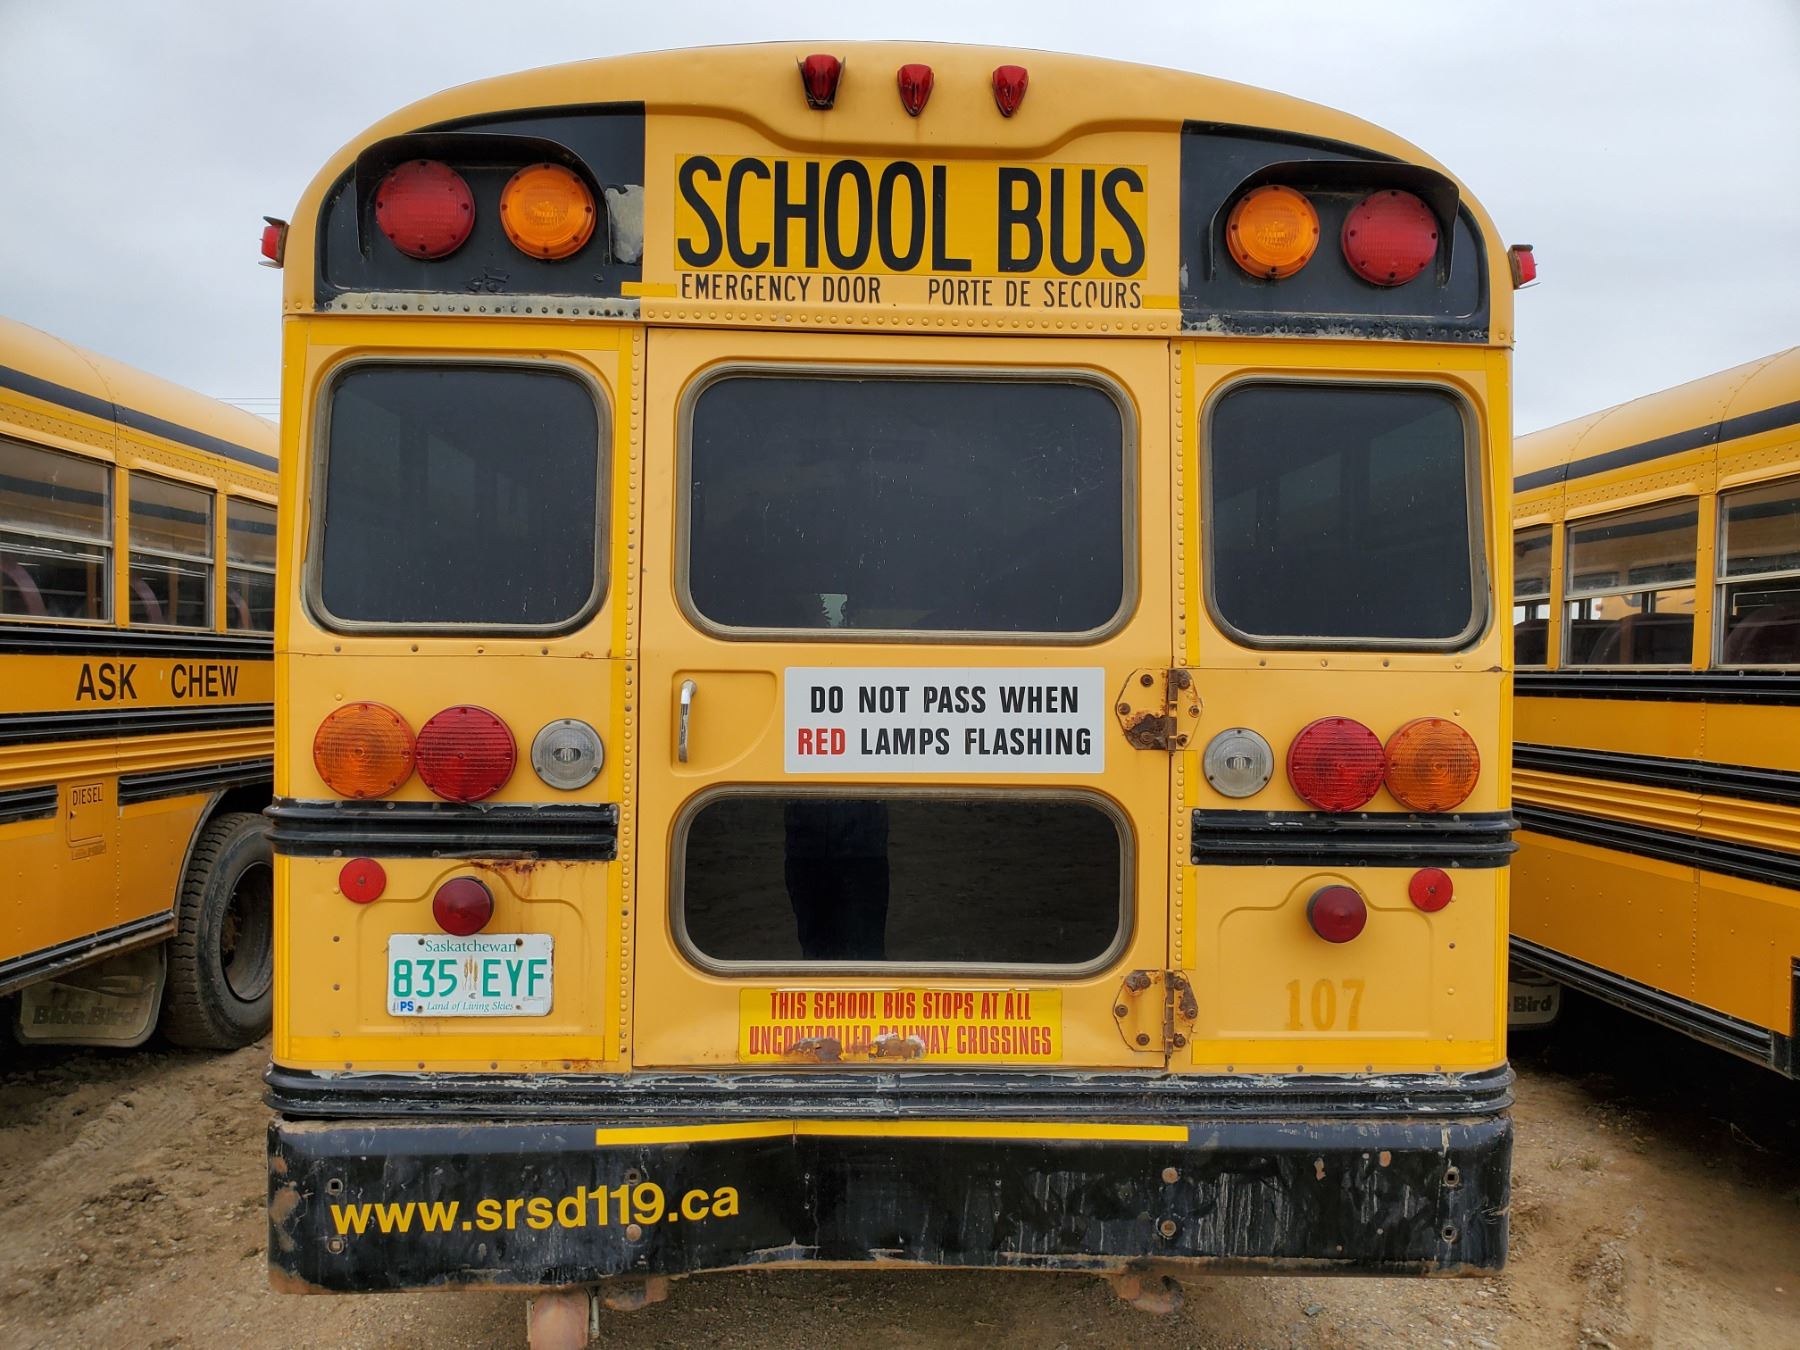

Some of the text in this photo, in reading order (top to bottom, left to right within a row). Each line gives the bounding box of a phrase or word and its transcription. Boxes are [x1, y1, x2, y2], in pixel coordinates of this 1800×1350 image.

[677, 155, 1146, 278] SCHOOL BUS
[681, 273, 881, 304] EMERGENCY DOOR
[928, 278, 1142, 309] PORTE DE SECOURS
[75, 662, 239, 701] ASK CHEW
[810, 686, 1079, 713] DO NOT PASS WHEN
[797, 728, 1091, 756] RED LAMPS FLASHING
[72, 786, 103, 807] DIESEL
[425, 938, 518, 953] Saskatchewan
[393, 959, 547, 998] 835 EYF
[400, 1001, 414, 1012] PS
[426, 1001, 514, 1013] Land of Living Skies
[770, 992, 1031, 1020] THIS SCHOOL BUS STOPS AT ALL
[1284, 978, 1366, 1032] 107
[1513, 995, 1552, 1012] Bird
[956, 1025, 1052, 1055] CROSSINGS
[330, 1182, 739, 1235] www.srsd119.ca
